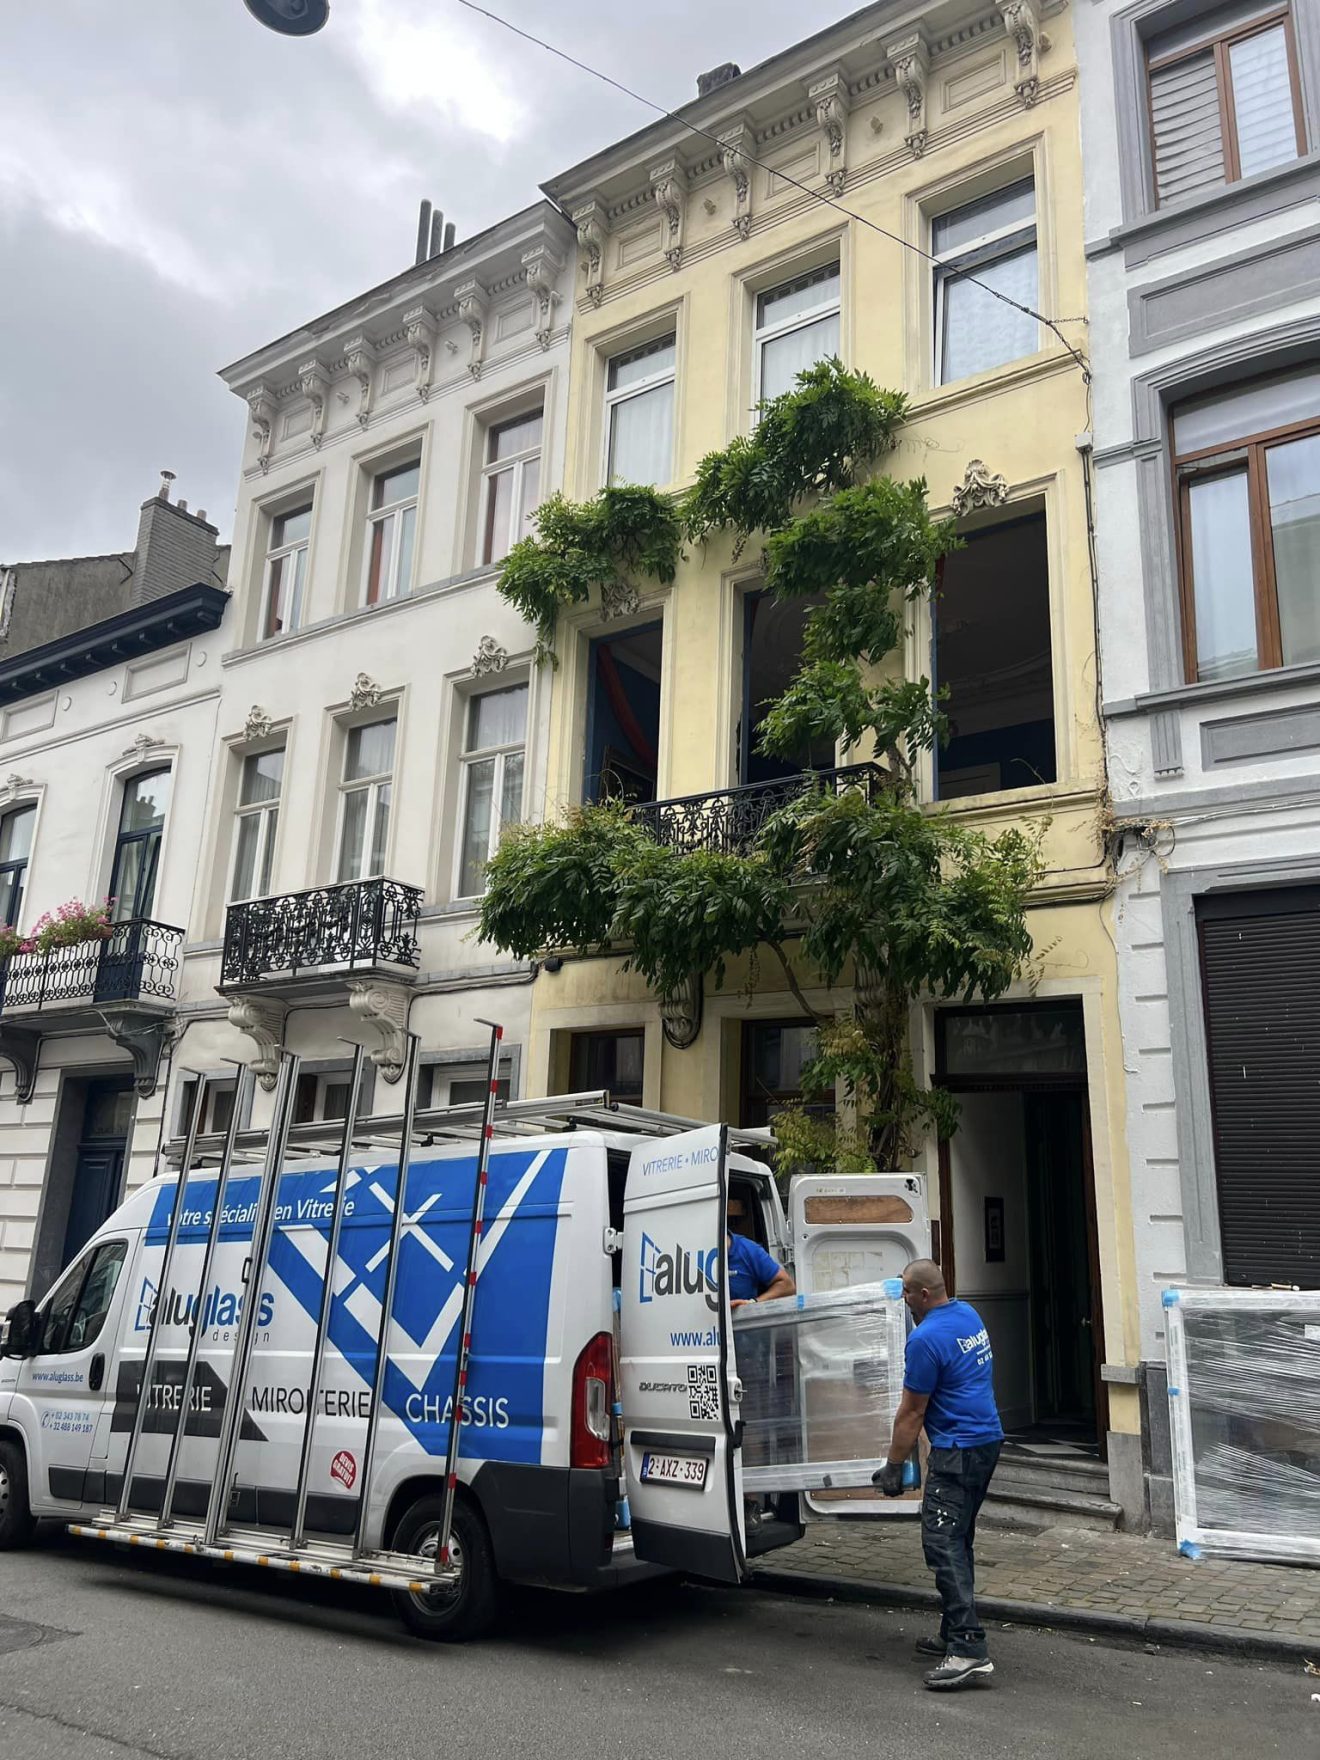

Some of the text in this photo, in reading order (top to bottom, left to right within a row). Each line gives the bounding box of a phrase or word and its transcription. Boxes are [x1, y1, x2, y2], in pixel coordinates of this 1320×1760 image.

[642, 1154, 683, 1176] VITRERIE
[274, 1205, 292, 1220] en
[297, 1196, 355, 1219] Vitreie
[32, 1371, 84, 1384] www.aluglass.be
[639, 1382, 688, 1392] DUCATO
[251, 1386, 370, 1418] MIROIERIE
